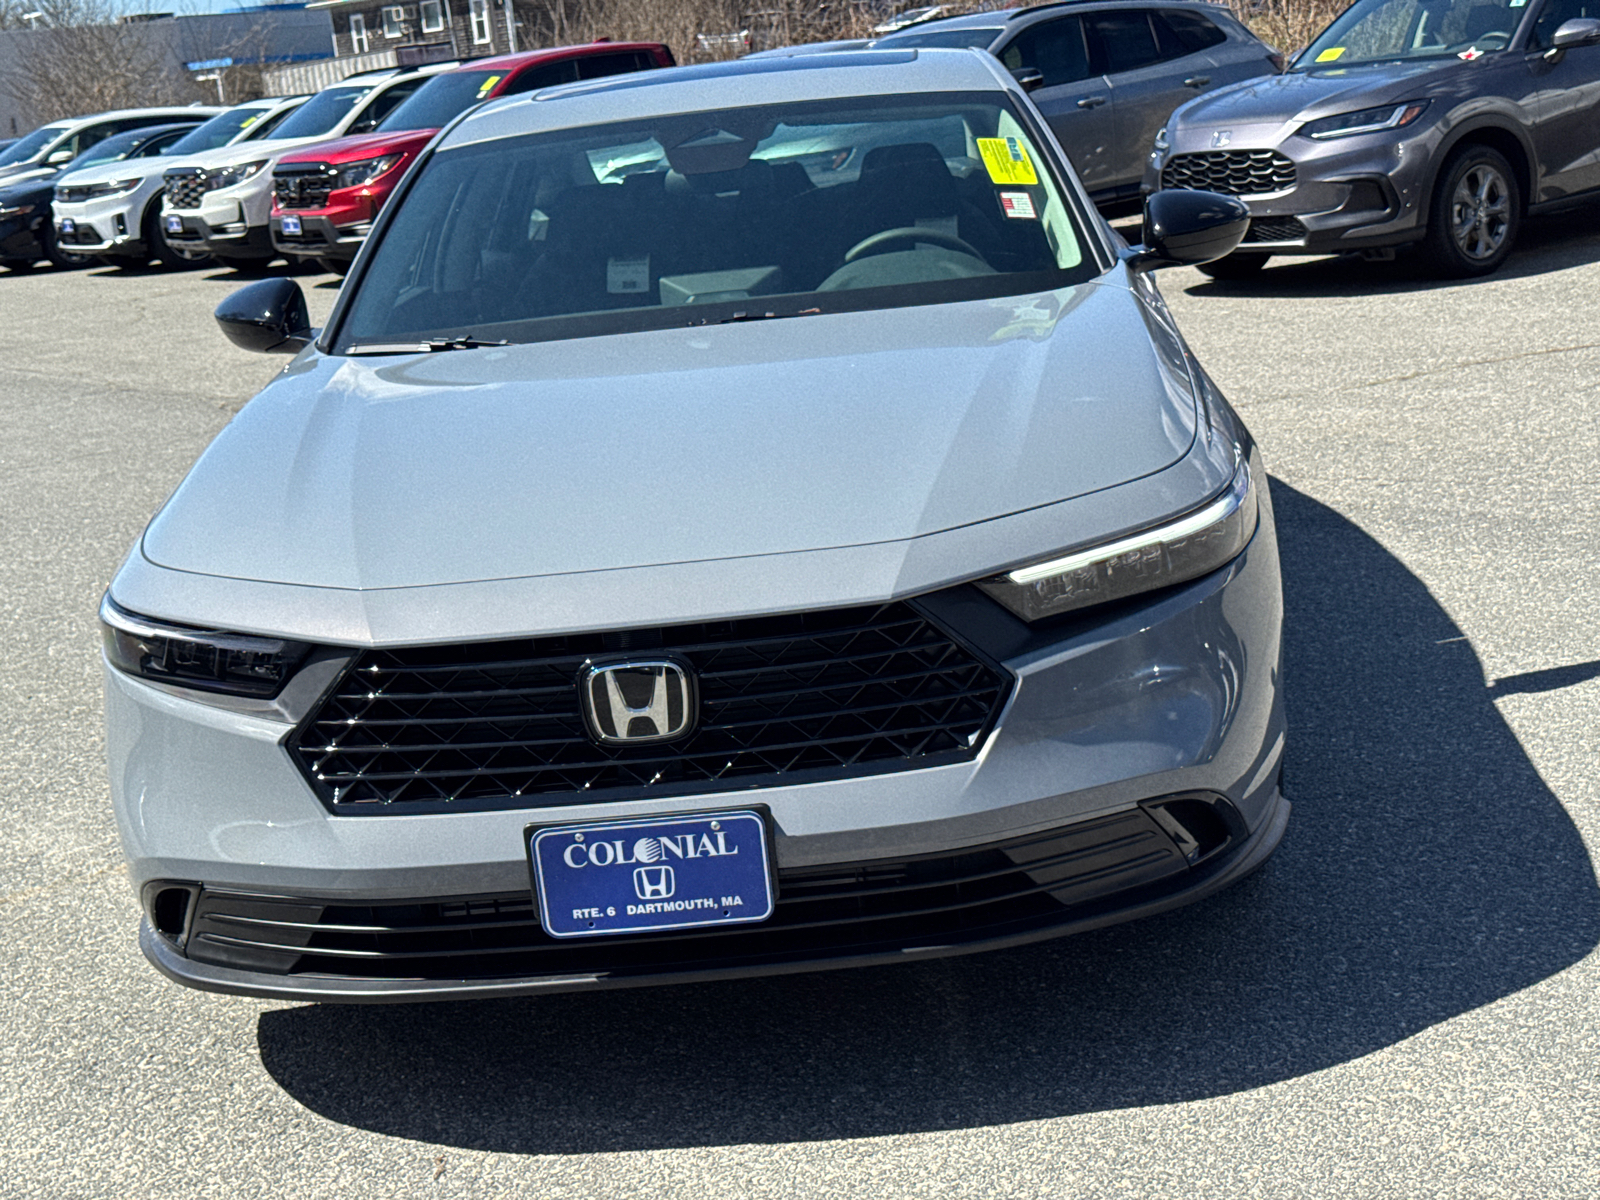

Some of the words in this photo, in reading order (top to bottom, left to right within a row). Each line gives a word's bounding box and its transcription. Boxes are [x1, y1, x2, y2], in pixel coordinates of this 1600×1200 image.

[563, 831, 739, 868] COLONIAL
[572, 907, 604, 919] RTE.
[606, 906, 616, 917] 6
[626, 897, 718, 916] DARTMOUTH,
[720, 895, 743, 907] MA
